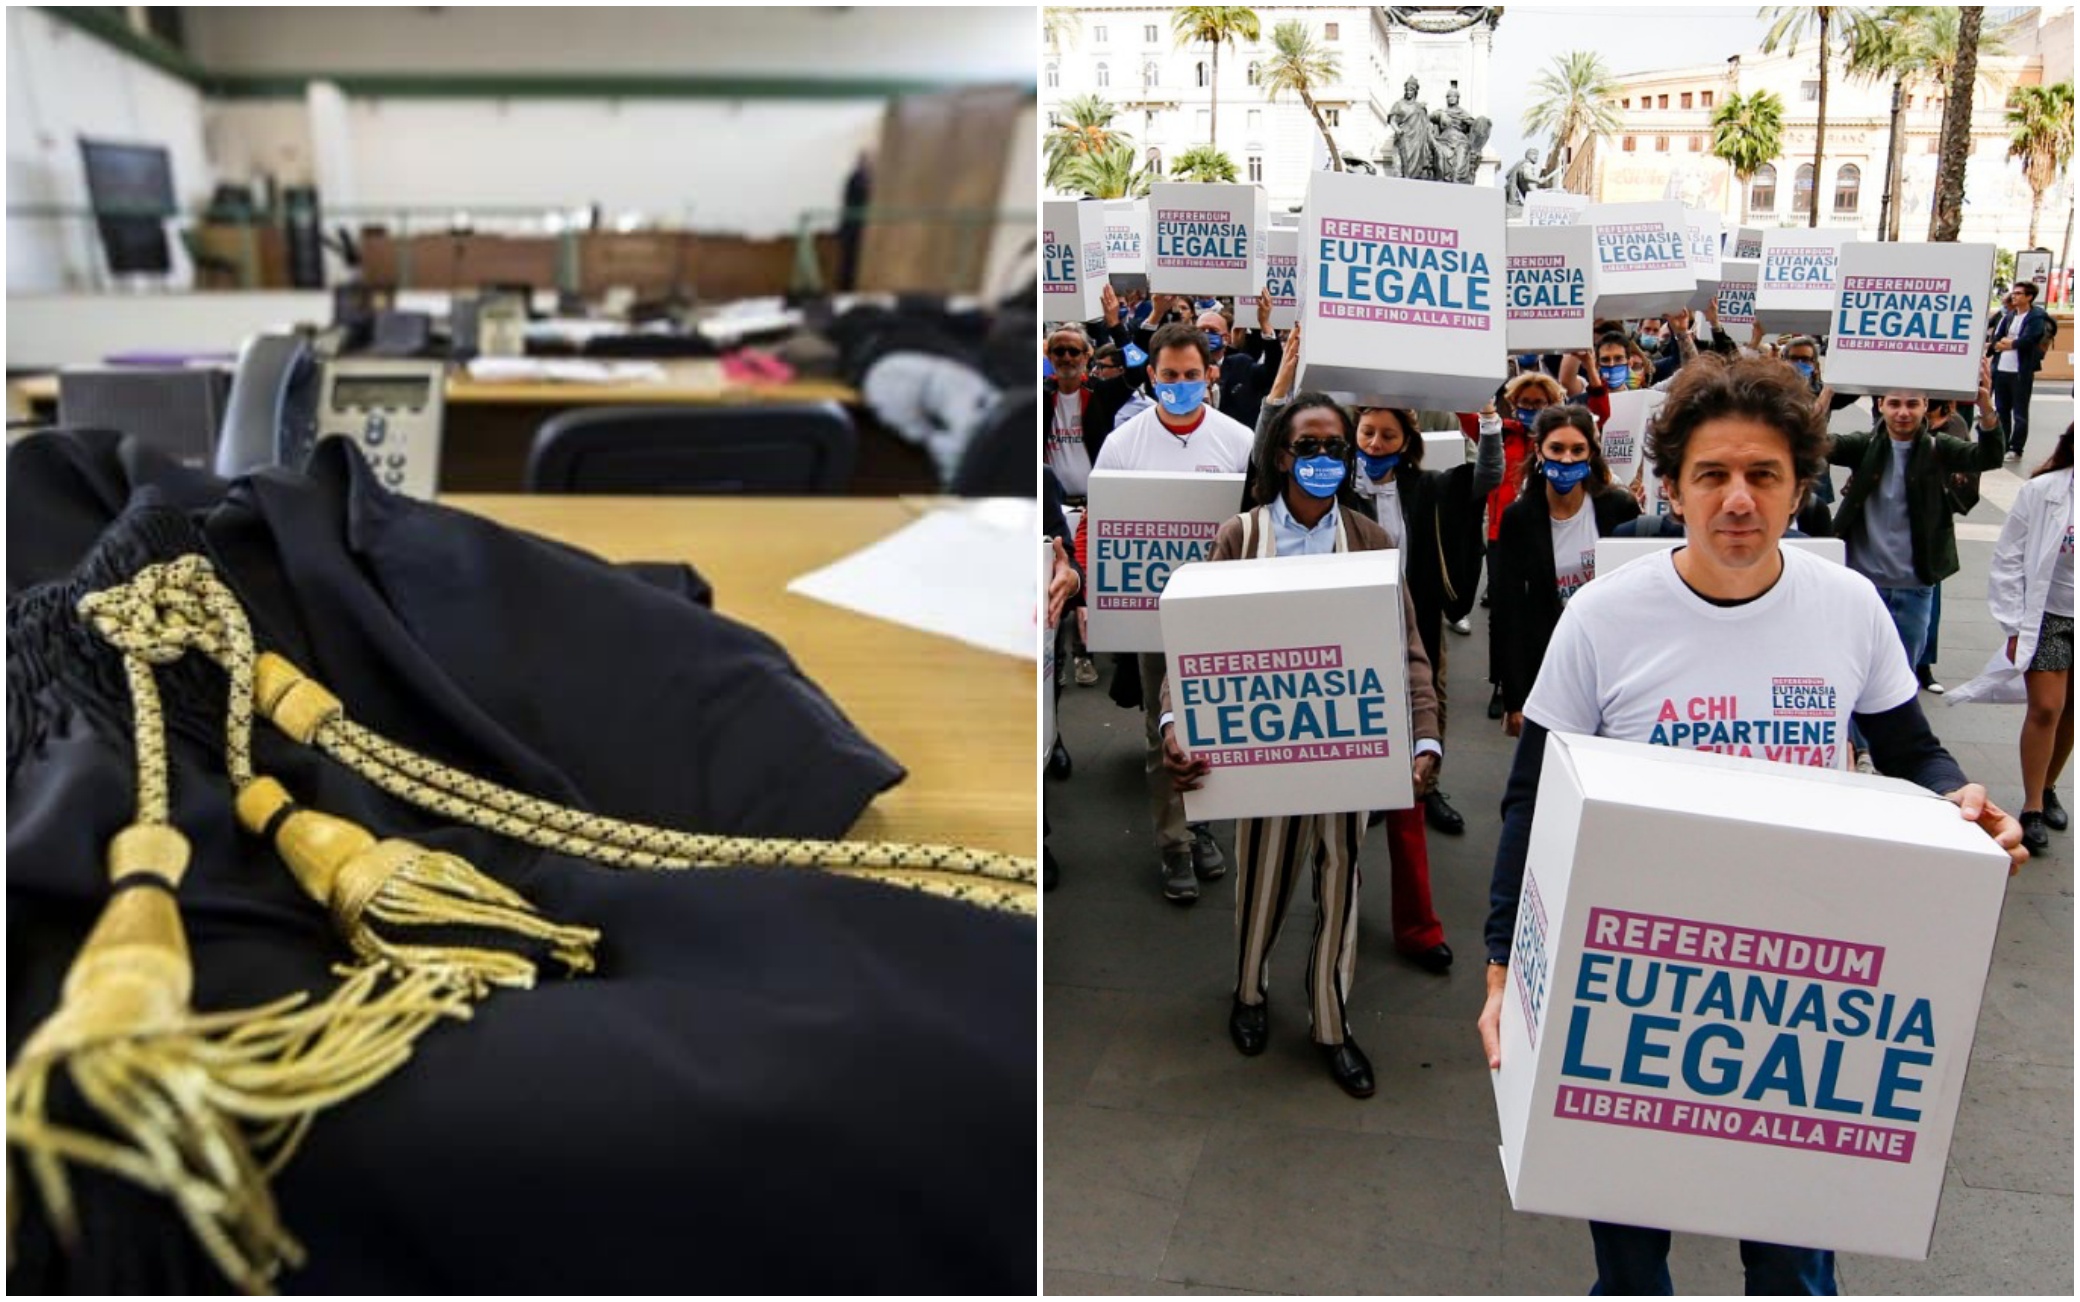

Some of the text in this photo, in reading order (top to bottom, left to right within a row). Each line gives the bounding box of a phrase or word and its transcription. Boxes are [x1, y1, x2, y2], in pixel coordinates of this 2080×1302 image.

[1158, 210, 1229, 221] REFERENDUM
[1157, 222, 1247, 237] EUTANASIA
[1325, 220, 1455, 246] REFERENDUM
[1597, 231, 1682, 246] EUTANASIA
[1043, 244, 1074, 258] SIA
[1157, 236, 1248, 258] LEGALE
[1320, 238, 1490, 275] EUTANASIA
[1599, 243, 1685, 263] LEGALE
[1767, 256, 1838, 267] EUTANASI
[1507, 268, 1585, 284] TANASIA
[1765, 267, 1833, 281] LEGAL
[1846, 277, 1947, 291] REFERENDUM
[1319, 264, 1490, 311] LEGALE
[1841, 292, 1973, 312] EUTANASIA
[1323, 305, 1486, 328] LIBERI FINO ALLA FINE
[1838, 310, 1973, 340] LEGALE
[1840, 340, 1966, 353] LIBERI FINO ALLA FINE
[1101, 522, 1216, 537] REFERENDUM
[1100, 598, 1141, 607] LIBERI
[1184, 648, 1337, 674] REFERENDUM
[1181, 668, 1384, 705] EUTANASIA
[1772, 686, 1836, 695] EUTANASIA
[1656, 695, 1738, 723] A CHI
[1773, 695, 1836, 709] LEGALE
[1185, 697, 1388, 747] LEGALE
[1648, 720, 1836, 746] APPARTIENE
[1254, 749, 1293, 762] FINO
[1299, 745, 1340, 759] ALLA
[1346, 741, 1385, 757] FINE
[1764, 745, 1836, 768] VITA?
[1594, 914, 1875, 980] REFERENDUM
[1574, 952, 1936, 1048] EUTANASIA
[1561, 1005, 1935, 1124] LEGALE
[1563, 1090, 1907, 1156] LIBERI FINO ALLA FINE
